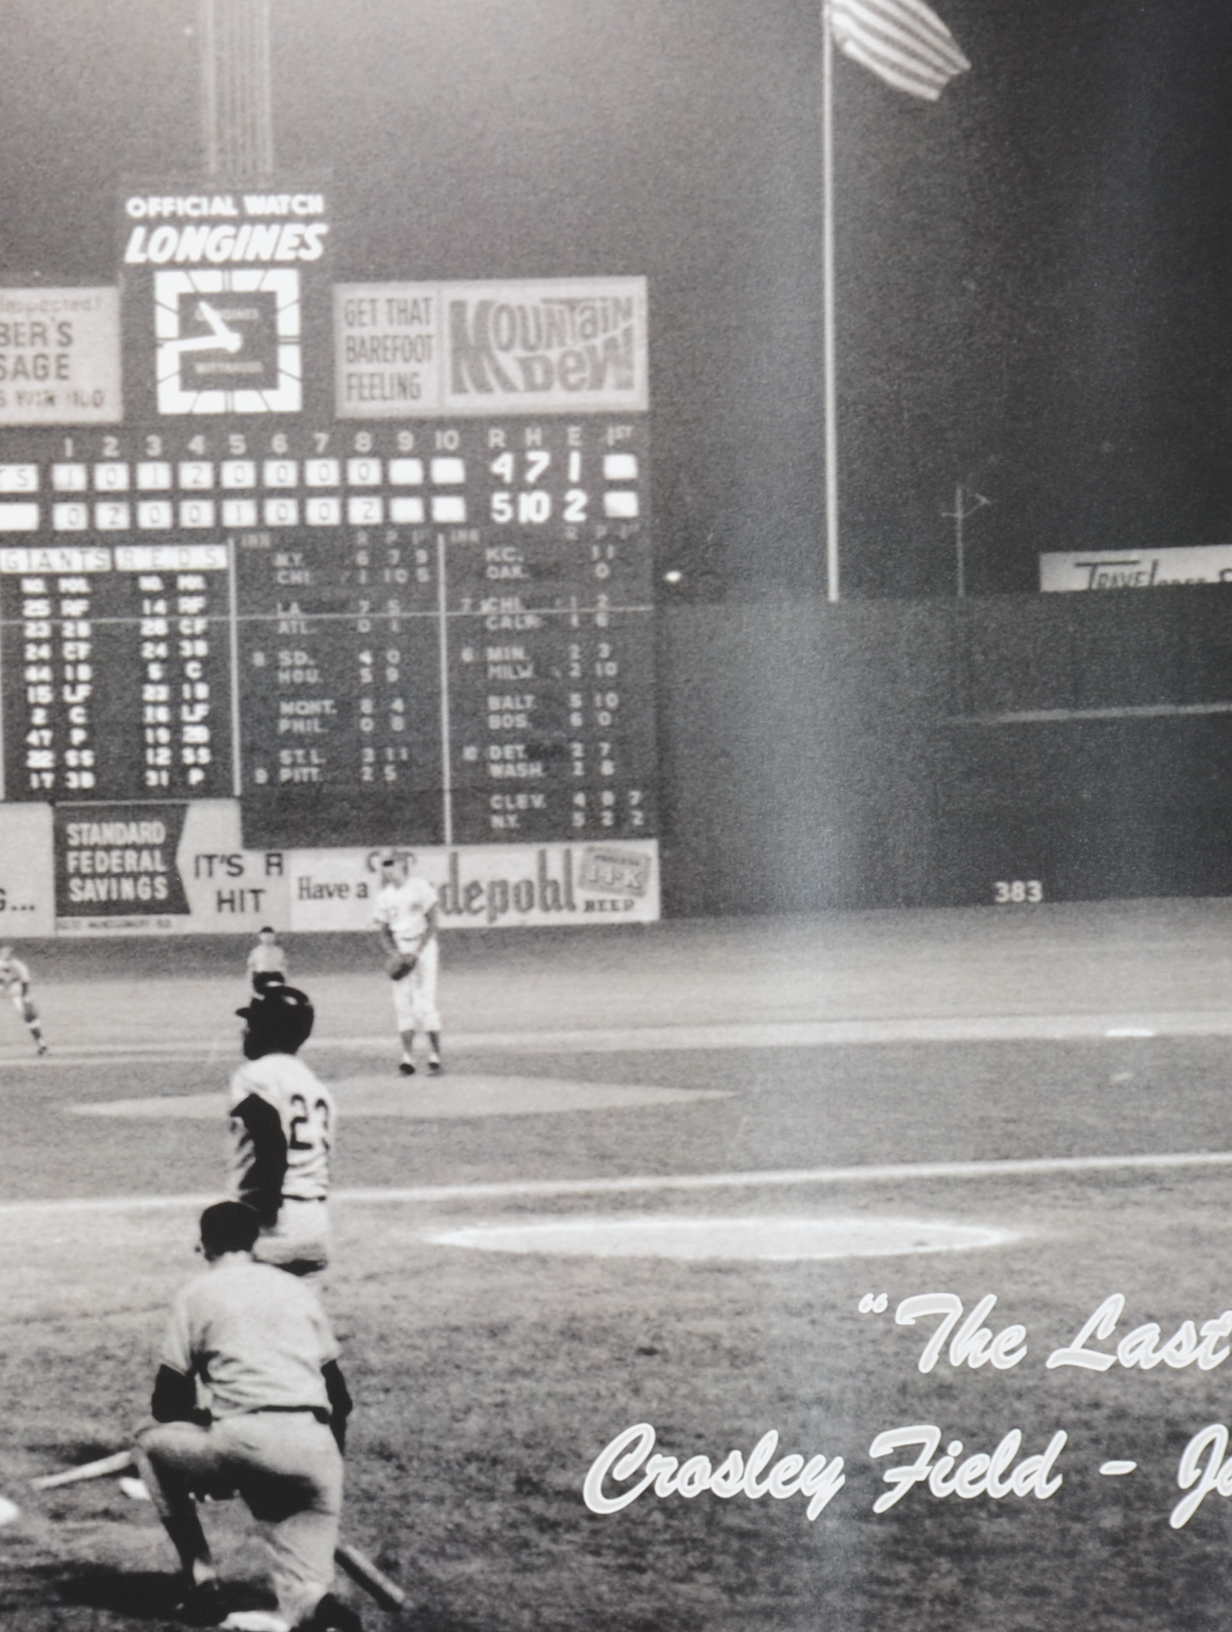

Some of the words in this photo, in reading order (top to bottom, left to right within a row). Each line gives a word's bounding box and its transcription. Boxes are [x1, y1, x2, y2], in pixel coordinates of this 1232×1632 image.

[125, 195, 238, 218] OFFICIAL
[243, 193, 325, 215] WATCH
[123, 222, 328, 264] LONGINES
[344, 298, 377, 327] GET
[386, 297, 433, 325] THAT
[345, 333, 434, 364] BAREFOOT
[346, 371, 422, 402] FEELING
[64, 438, 74, 458] 1
[102, 436, 121, 457] 2
[145, 435, 163, 457] 3
[187, 434, 206, 456] 4
[229, 433, 246, 455] 5
[272, 433, 288, 454] 6
[314, 432, 330, 453] 7
[354, 431, 372, 452] 8
[397, 430, 415, 452] 9
[434, 430, 461, 451] 10
[488, 428, 506, 449] R
[524, 427, 543, 448] H
[567, 427, 582, 448] E
[490, 452, 515, 484] 4
[524, 450, 551, 484] 7
[569, 450, 581, 483] 1
[490, 491, 513, 524] 5
[518, 490, 552, 524] 10
[563, 489, 589, 523] 2
[5, 549, 109, 571] GIANTS
[122, 548, 220, 568] REDS
[142, 598, 168, 616] 14
[177, 595, 207, 614] RF
[178, 618, 208, 635] CF
[24, 643, 52, 661] 24
[140, 642, 169, 660] 24
[179, 639, 209, 657] 3B
[184, 660, 203, 680] C
[27, 685, 54, 704] 15
[62, 684, 93, 703] LF
[142, 683, 170, 702] 23
[30, 707, 48, 726] 2
[68, 706, 88, 725] C
[180, 703, 210, 722] LF
[25, 728, 54, 747] 47
[69, 727, 88, 746] P
[25, 749, 56, 769] 22
[64, 748, 96, 768] SS
[145, 746, 172, 766] 12
[181, 746, 212, 765] SS
[29, 772, 56, 790] 17
[144, 769, 170, 788] 31
[187, 767, 206, 786] P
[68, 820, 166, 847] STANDARD
[68, 848, 166, 874] FEDERAL
[194, 853, 245, 879] IT'S
[68, 875, 168, 901] SAVINGS
[298, 876, 347, 900] Have
[355, 880, 368, 899] a
[994, 880, 1043, 903] 383
[216, 888, 266, 914] HIT
